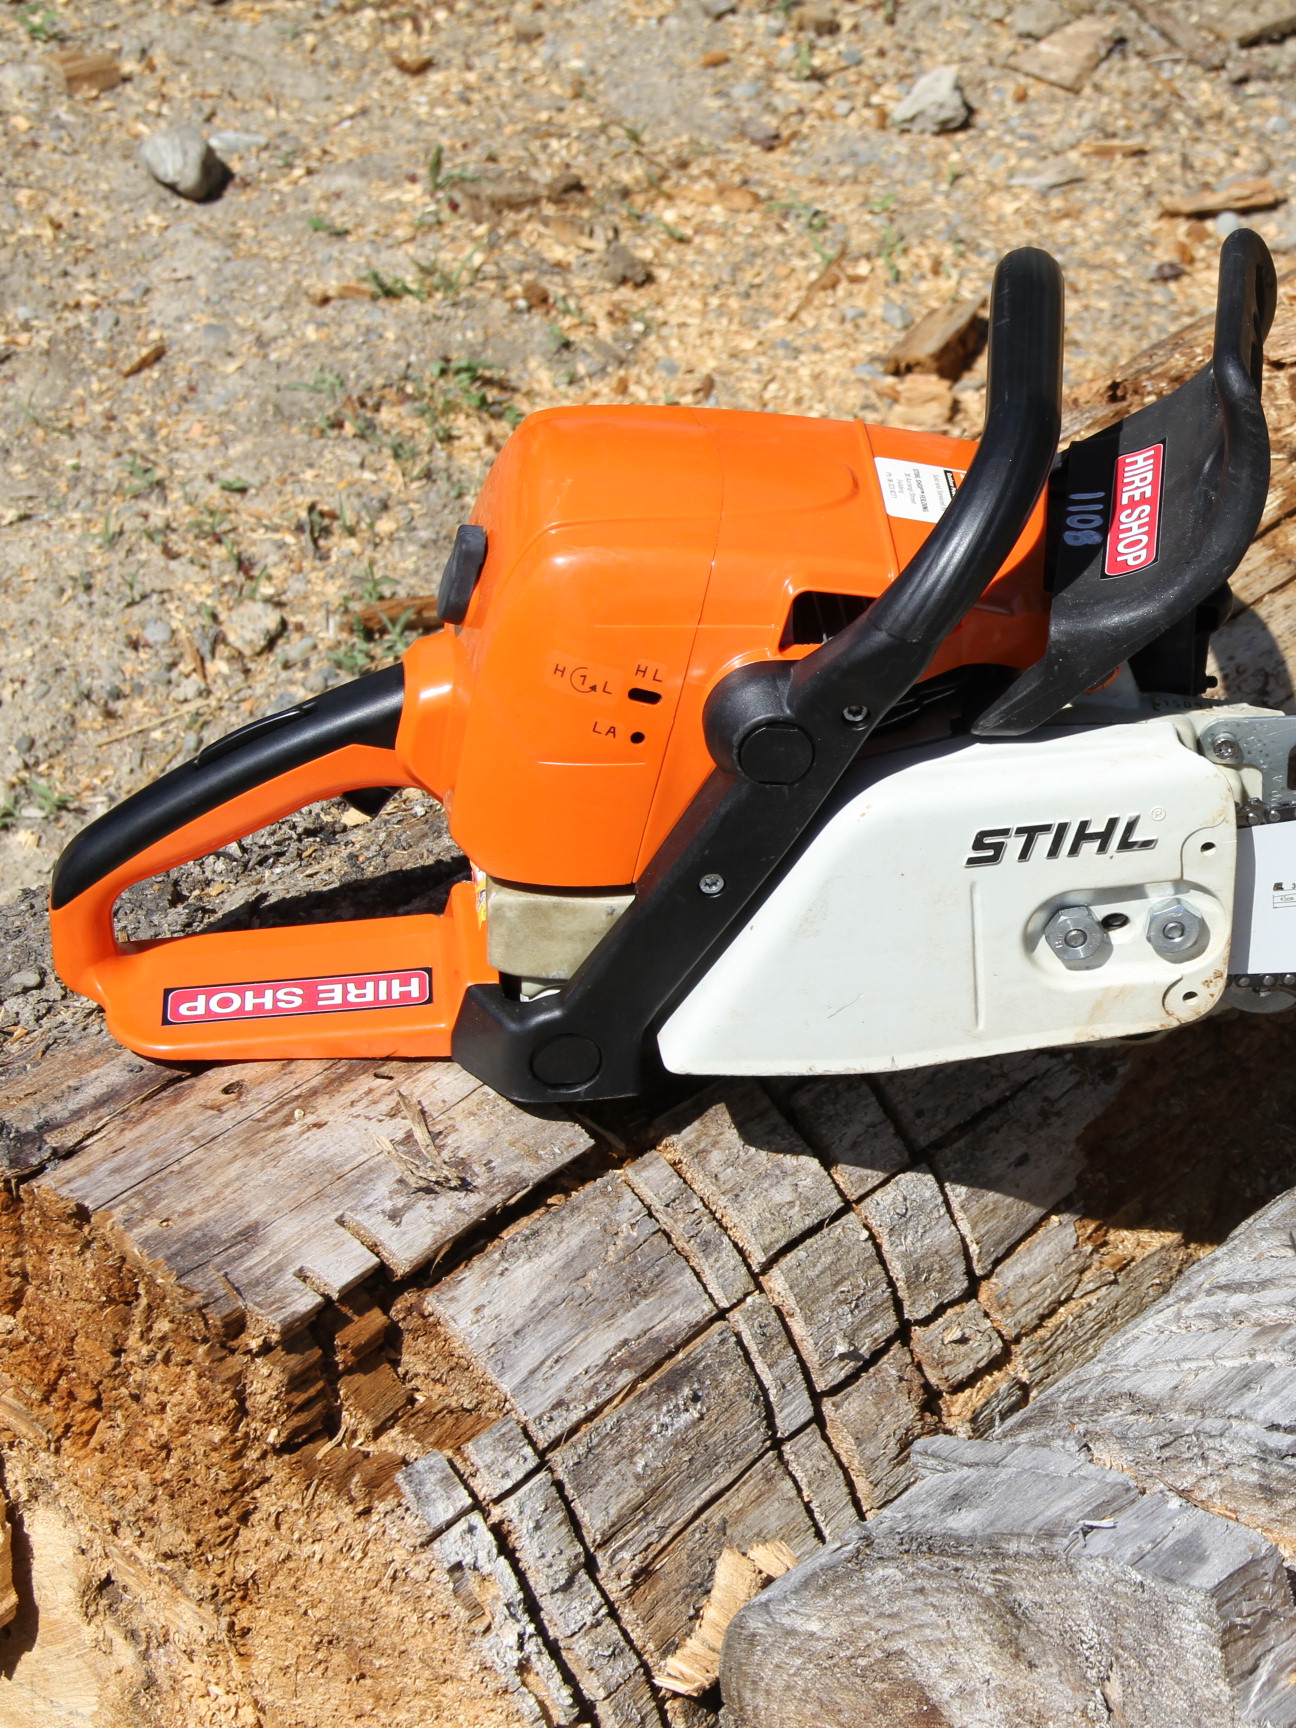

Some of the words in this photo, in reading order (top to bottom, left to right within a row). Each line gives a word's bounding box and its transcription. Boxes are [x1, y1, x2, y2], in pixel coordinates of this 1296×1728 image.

[1121, 449, 1155, 505] HIRE
[1115, 504, 1152, 567] SHOP
[964, 812, 1158, 868] STIHL
[178, 986, 304, 1016] SHOP
[317, 977, 420, 1006] HIRE
